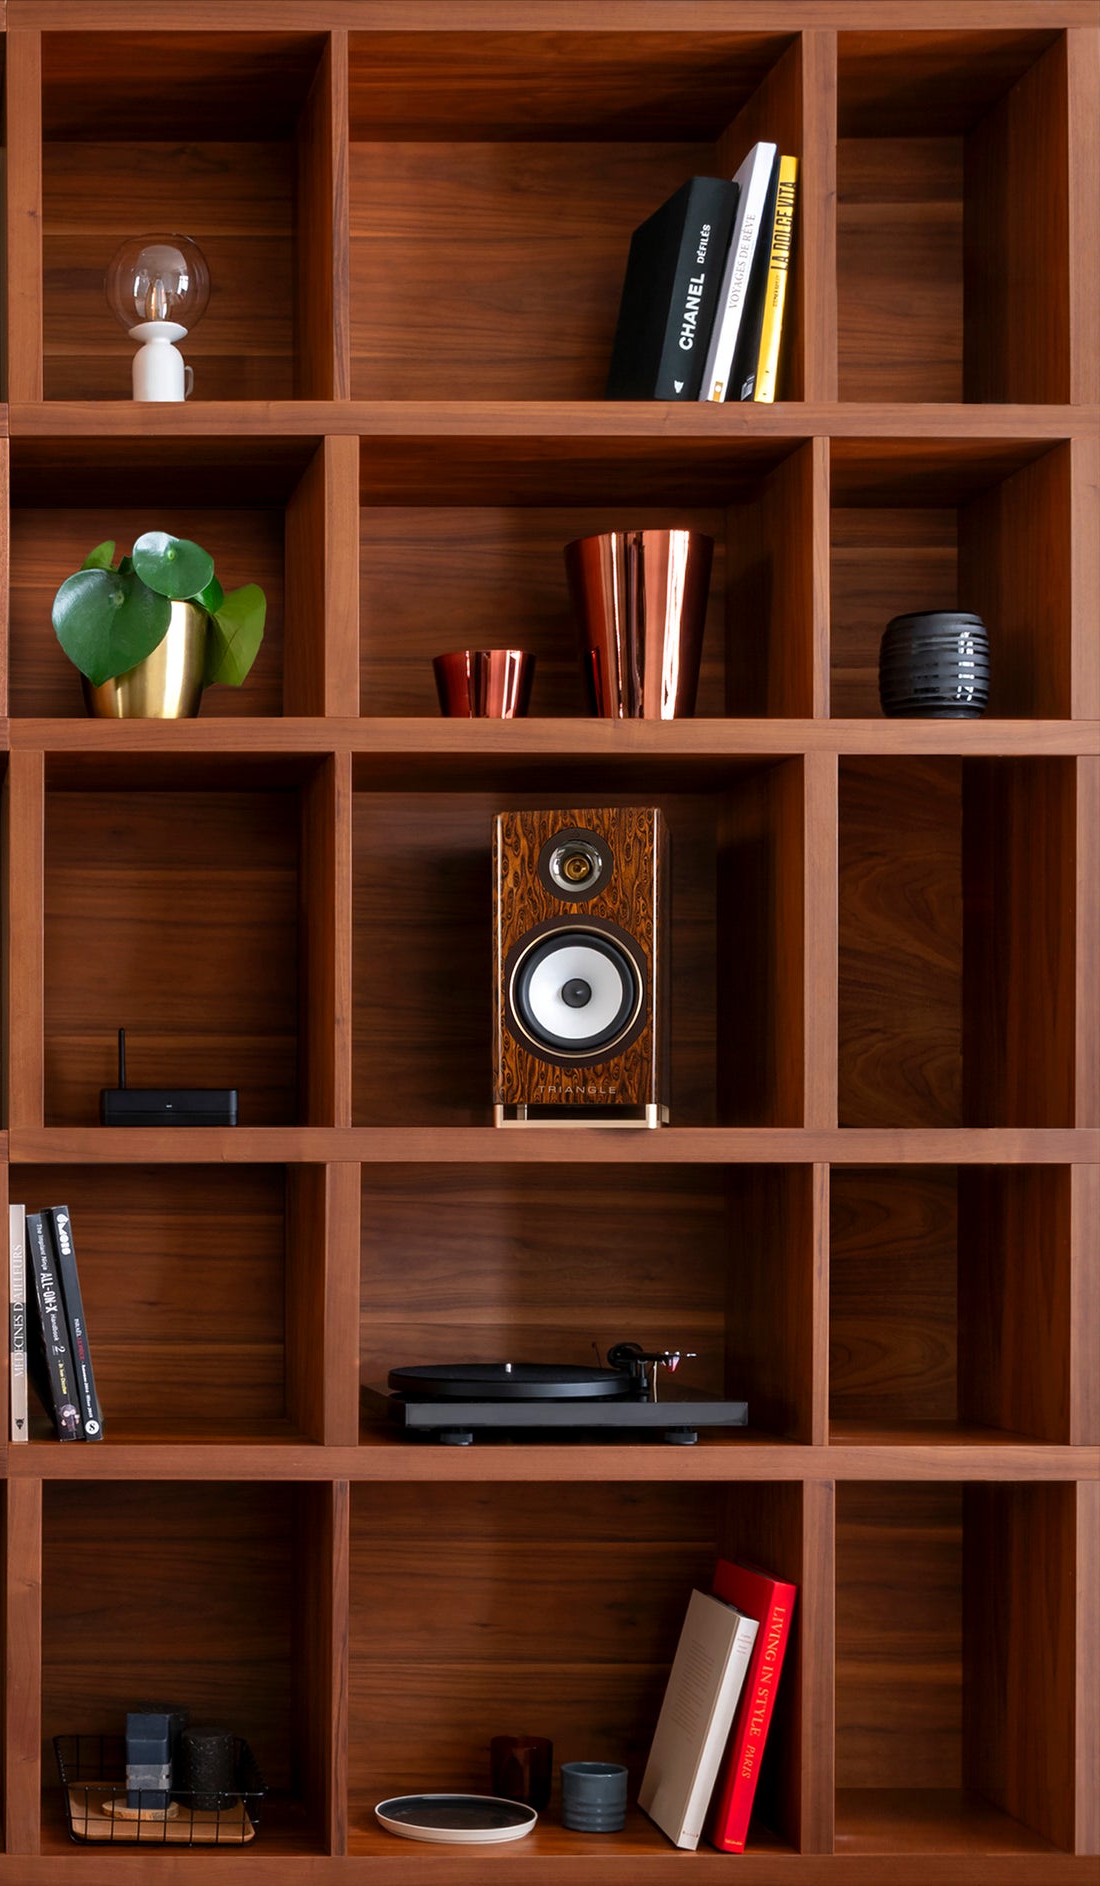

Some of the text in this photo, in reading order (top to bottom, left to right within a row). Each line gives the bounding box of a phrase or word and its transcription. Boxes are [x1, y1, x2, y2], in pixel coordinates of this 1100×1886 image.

[777, 182, 796, 207] VITA
[773, 210, 793, 252] DOLCE
[679, 224, 711, 350] CHANEL DÉFILÉS
[729, 261, 746, 309] VOYAGES
[739, 244, 749, 258] DE
[770, 256, 788, 270] LA
[538, 1086, 616, 1094] TRIANGLE
[40, 1272, 58, 1314] ALL-ON-X
[50, 1314, 59, 1341] Handbook
[741, 1606, 786, 1780] LIVING IN STYLE PARIS
